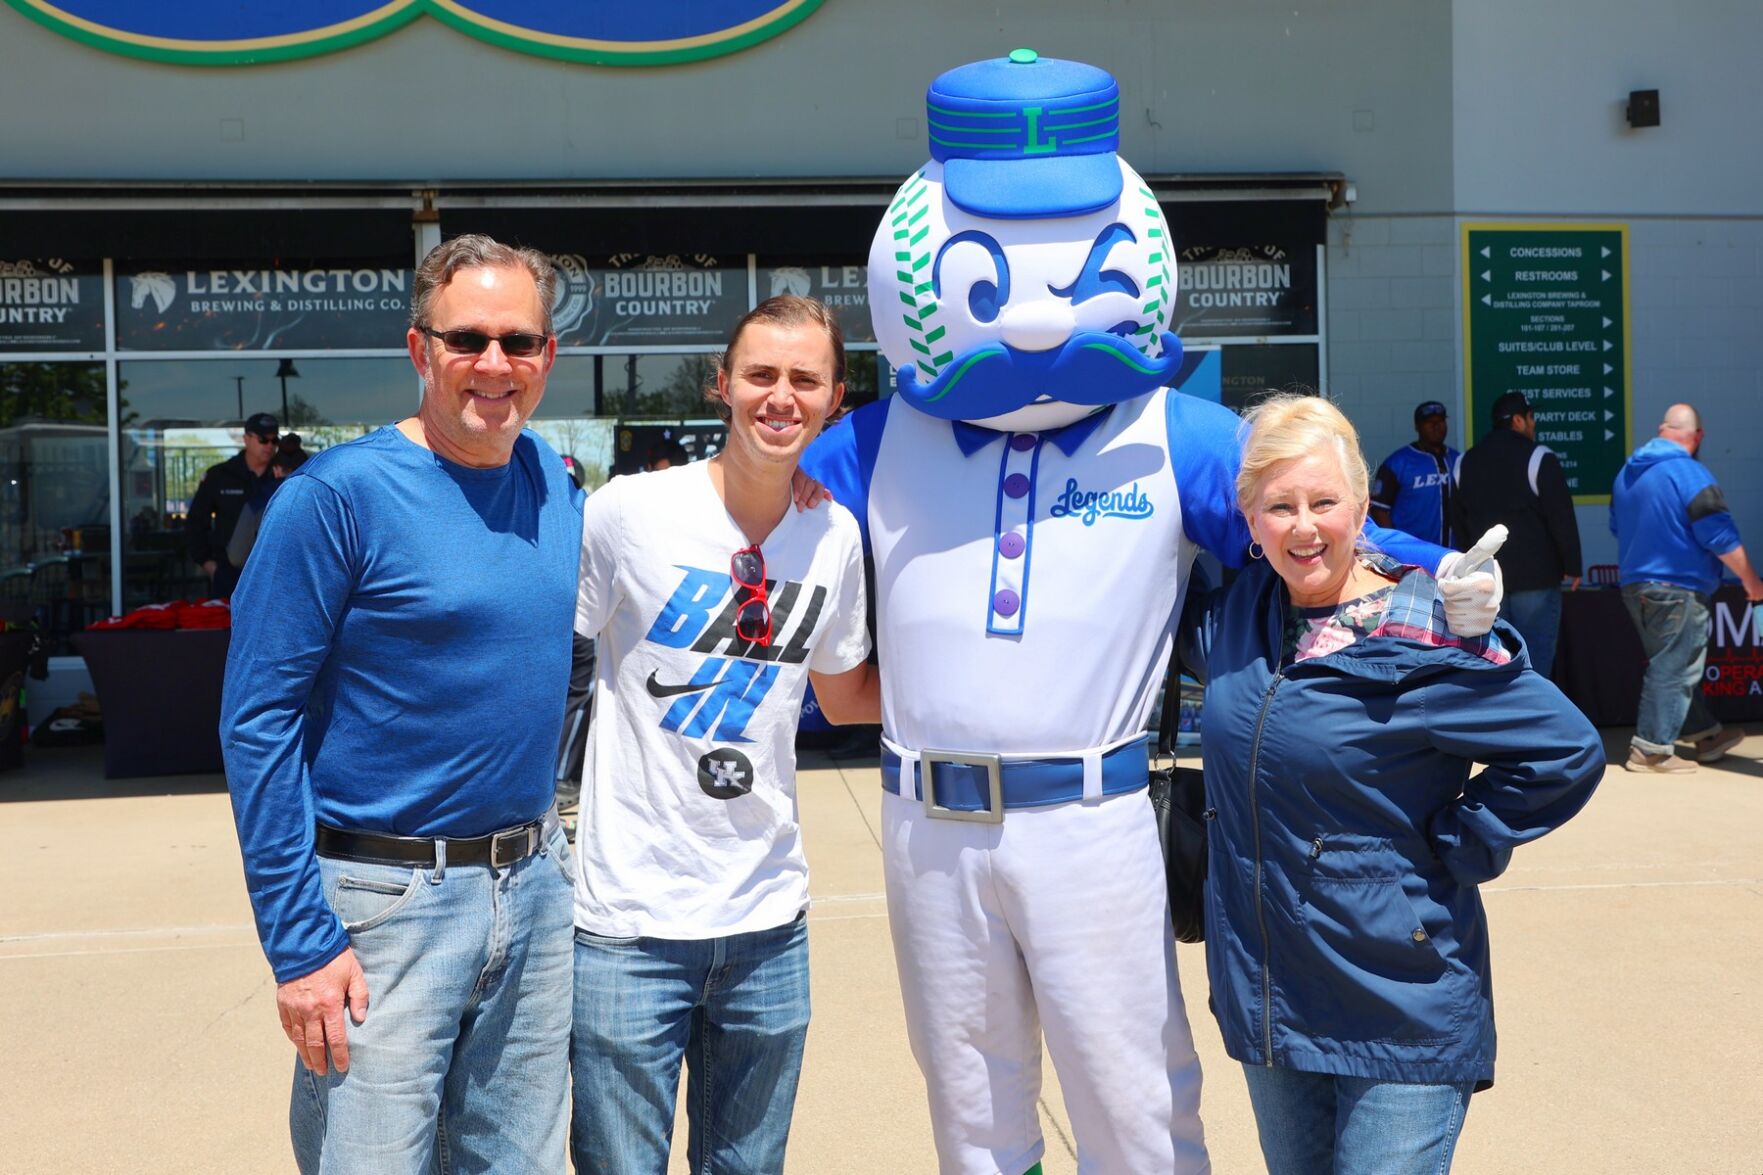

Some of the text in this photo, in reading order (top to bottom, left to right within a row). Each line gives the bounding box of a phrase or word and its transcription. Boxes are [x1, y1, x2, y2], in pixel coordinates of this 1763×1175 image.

[1022, 107, 1057, 154] L
[1510, 247, 1583, 258] CONCESSIONS
[187, 269, 405, 294] LEXINGTON
[1179, 263, 1291, 290] BOURBON
[1515, 271, 1579, 281] RESTROOMS
[0, 278, 79, 304] RBON
[604, 271, 722, 298] BOURBON
[191, 298, 406, 313] BREWING & DISTILLING CO.
[824, 294, 867, 306] BREW
[1189, 291, 1280, 308] COUNTRY
[616, 300, 712, 316] COUNTRY
[1498, 341, 1597, 352] SUITES/CLUB LEVEL
[1517, 365, 1580, 375] TEAM STORE
[1542, 388, 1592, 398] SERVICES
[1534, 411, 1596, 422] PARTY DECK
[1538, 431, 1583, 441] STABLES
[1050, 478, 1154, 527] Legends
[645, 564, 828, 664] BALL
